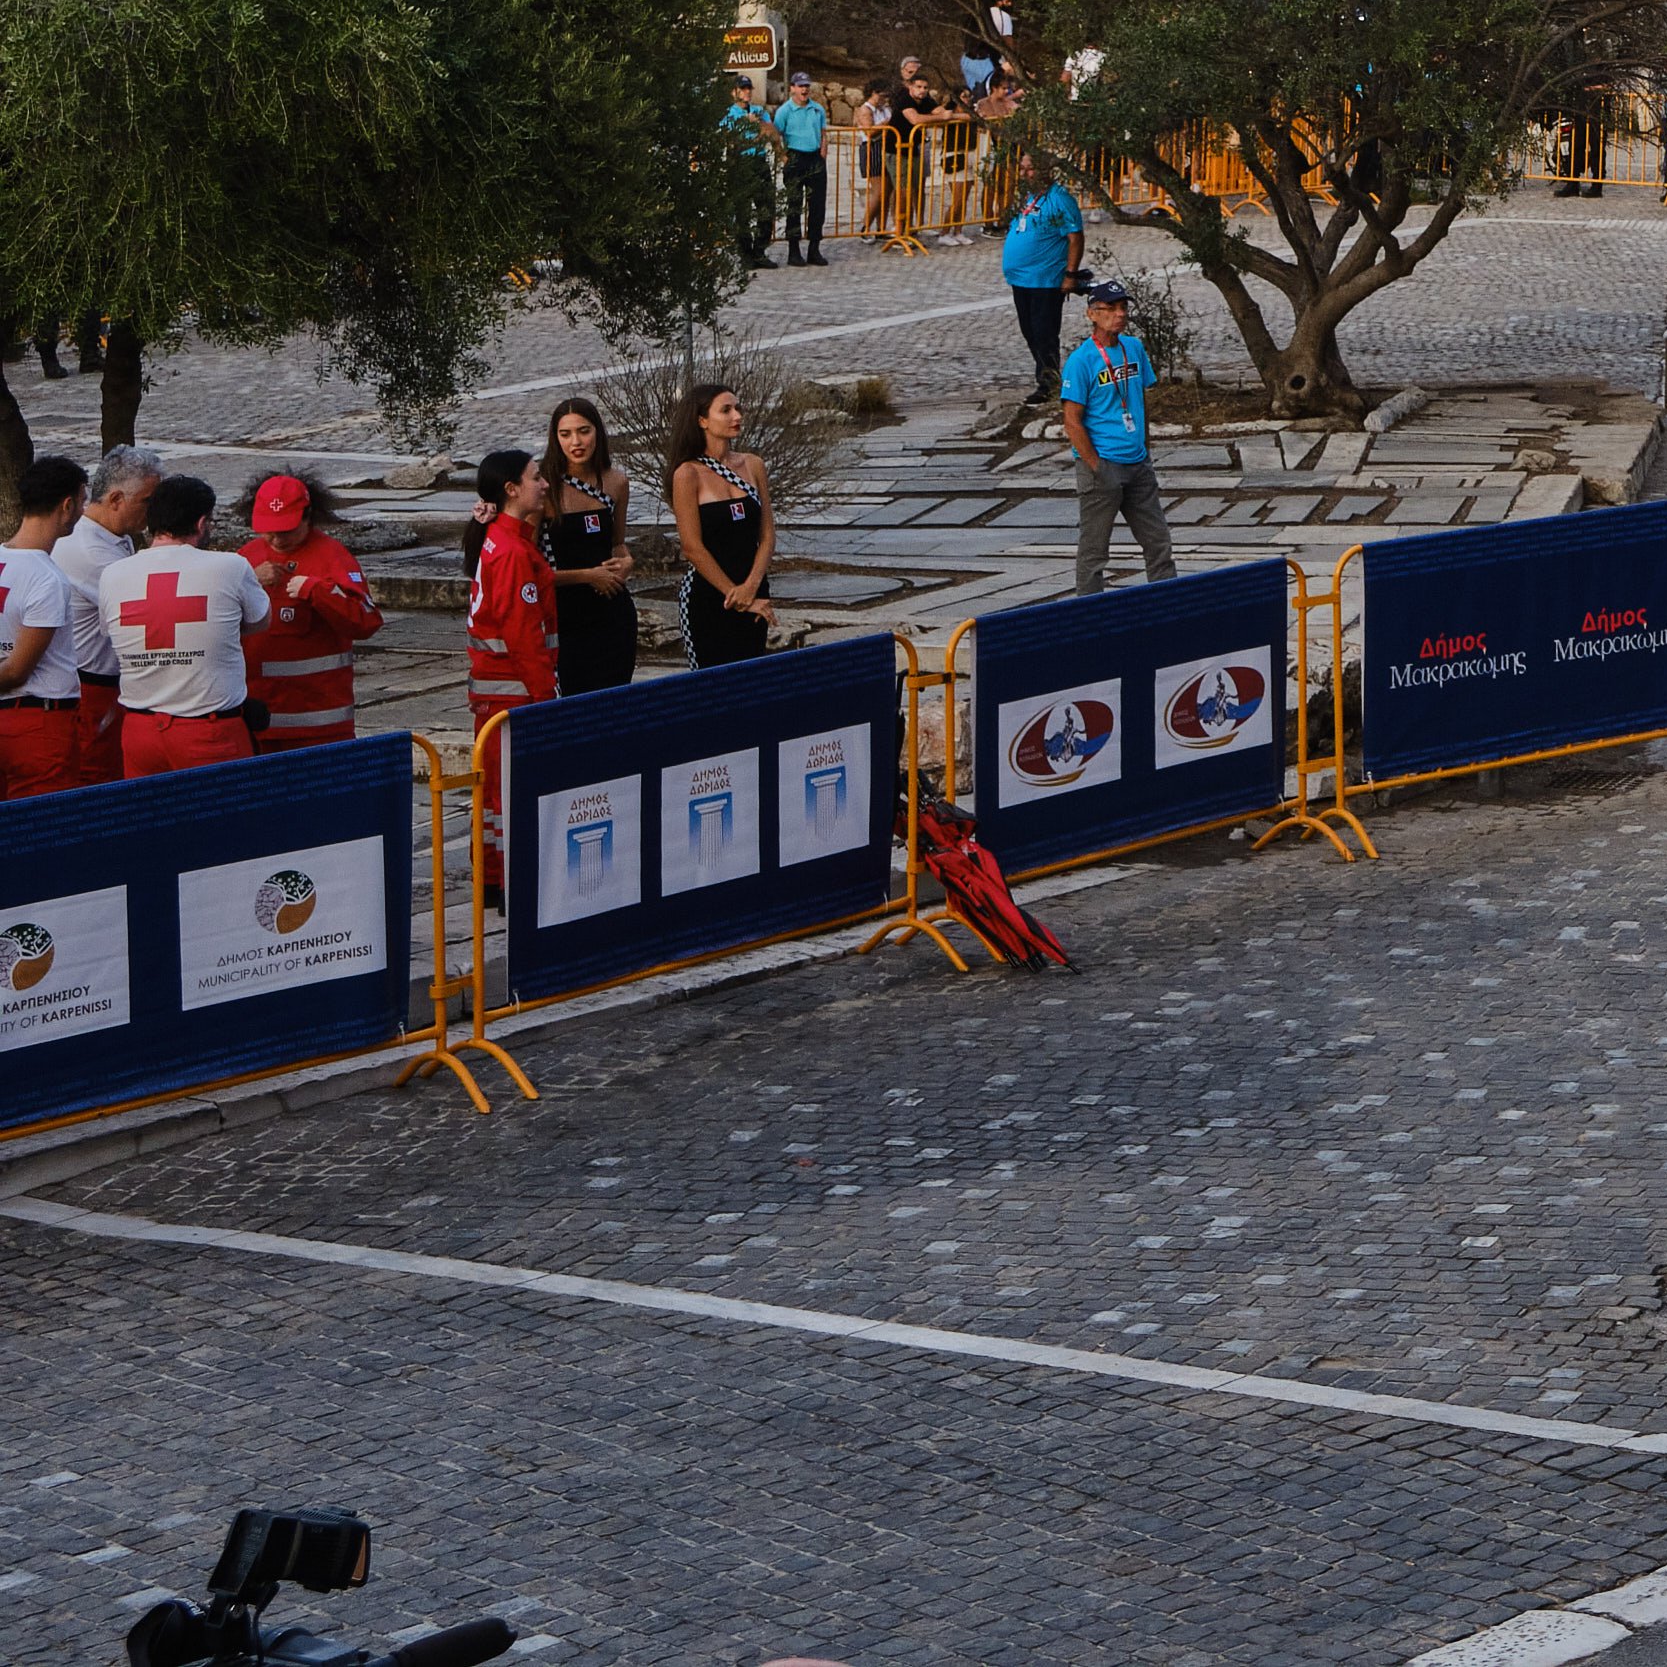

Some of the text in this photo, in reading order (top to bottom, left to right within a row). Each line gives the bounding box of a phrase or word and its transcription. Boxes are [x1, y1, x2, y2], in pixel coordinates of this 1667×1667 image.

[723, 32, 768, 44] Αττκού
[728, 51, 769, 63] Atticus
[1581, 607, 1647, 633] Δήμος
[1419, 633, 1487, 659] Δήμος
[172, 658, 192, 666] CROSS
[1390, 649, 1527, 689] Μακρακώμης
[808, 739, 842, 757] ΔΗΜΟΣ
[805, 750, 845, 769] ΔΩΡΙΔΟΣ
[692, 765, 729, 783] ΔΗΜΟΣ
[689, 777, 732, 796] ΔΩΡΙΔΟΣ
[570, 792, 609, 811] ΔΗΜΟΣ
[567, 804, 613, 824] ΔΩΡΙΔΟΣ
[216, 930, 353, 968] ΔΗΜΟΣ ΚΑΡΠΕΝΗΣΙΟΥ
[198, 945, 374, 990] MUNICIPALITY OF KARPENISSI
[2, 984, 91, 1015] ΚΑΡΠΕΝΗΣΙΟΥ
[20, 1015, 39, 1028] OF
[41, 998, 112, 1024] KARPENISSI
